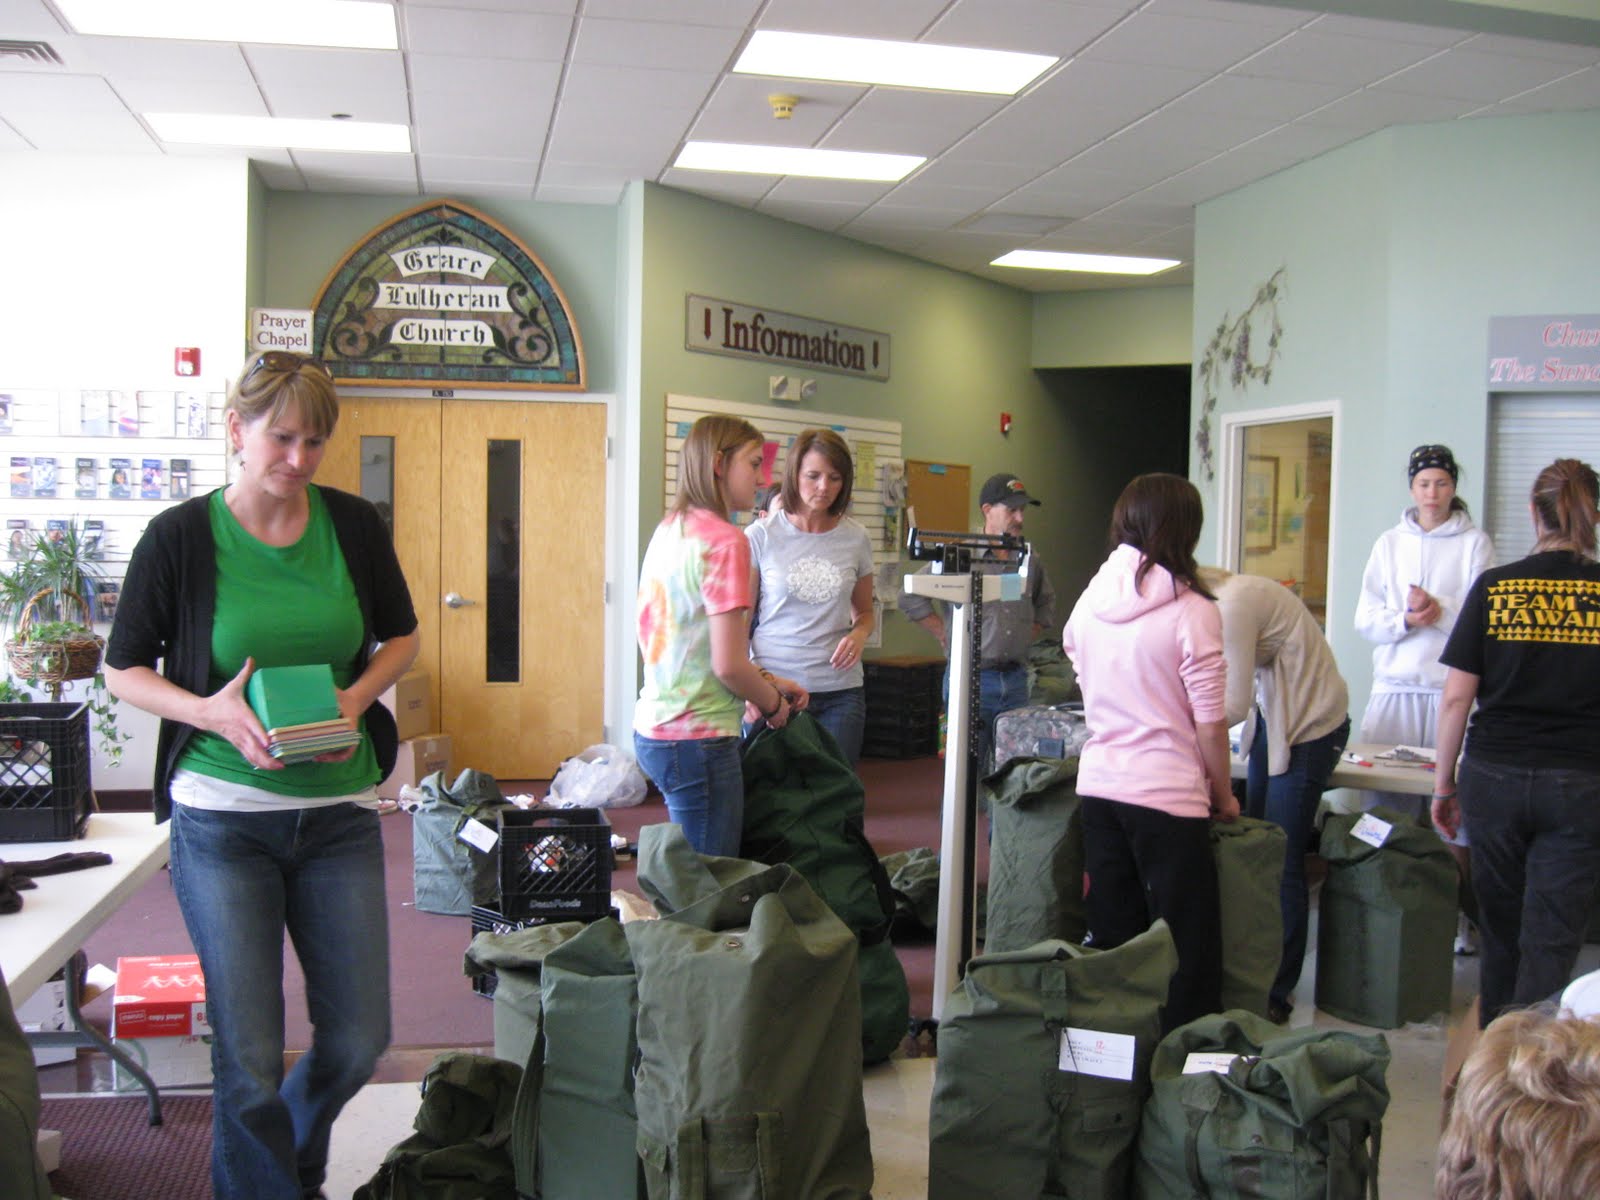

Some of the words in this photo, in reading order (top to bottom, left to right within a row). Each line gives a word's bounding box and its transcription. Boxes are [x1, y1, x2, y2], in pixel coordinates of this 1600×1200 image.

[403, 250, 482, 273] Grace
[385, 285, 500, 309] Lutheran
[259, 312, 306, 331] Prayer
[257, 331, 307, 349] Chapel
[399, 322, 485, 344] Church
[722, 307, 866, 371] Information
[1489, 357, 1536, 382] The
[1487, 593, 1576, 611] TEAM
